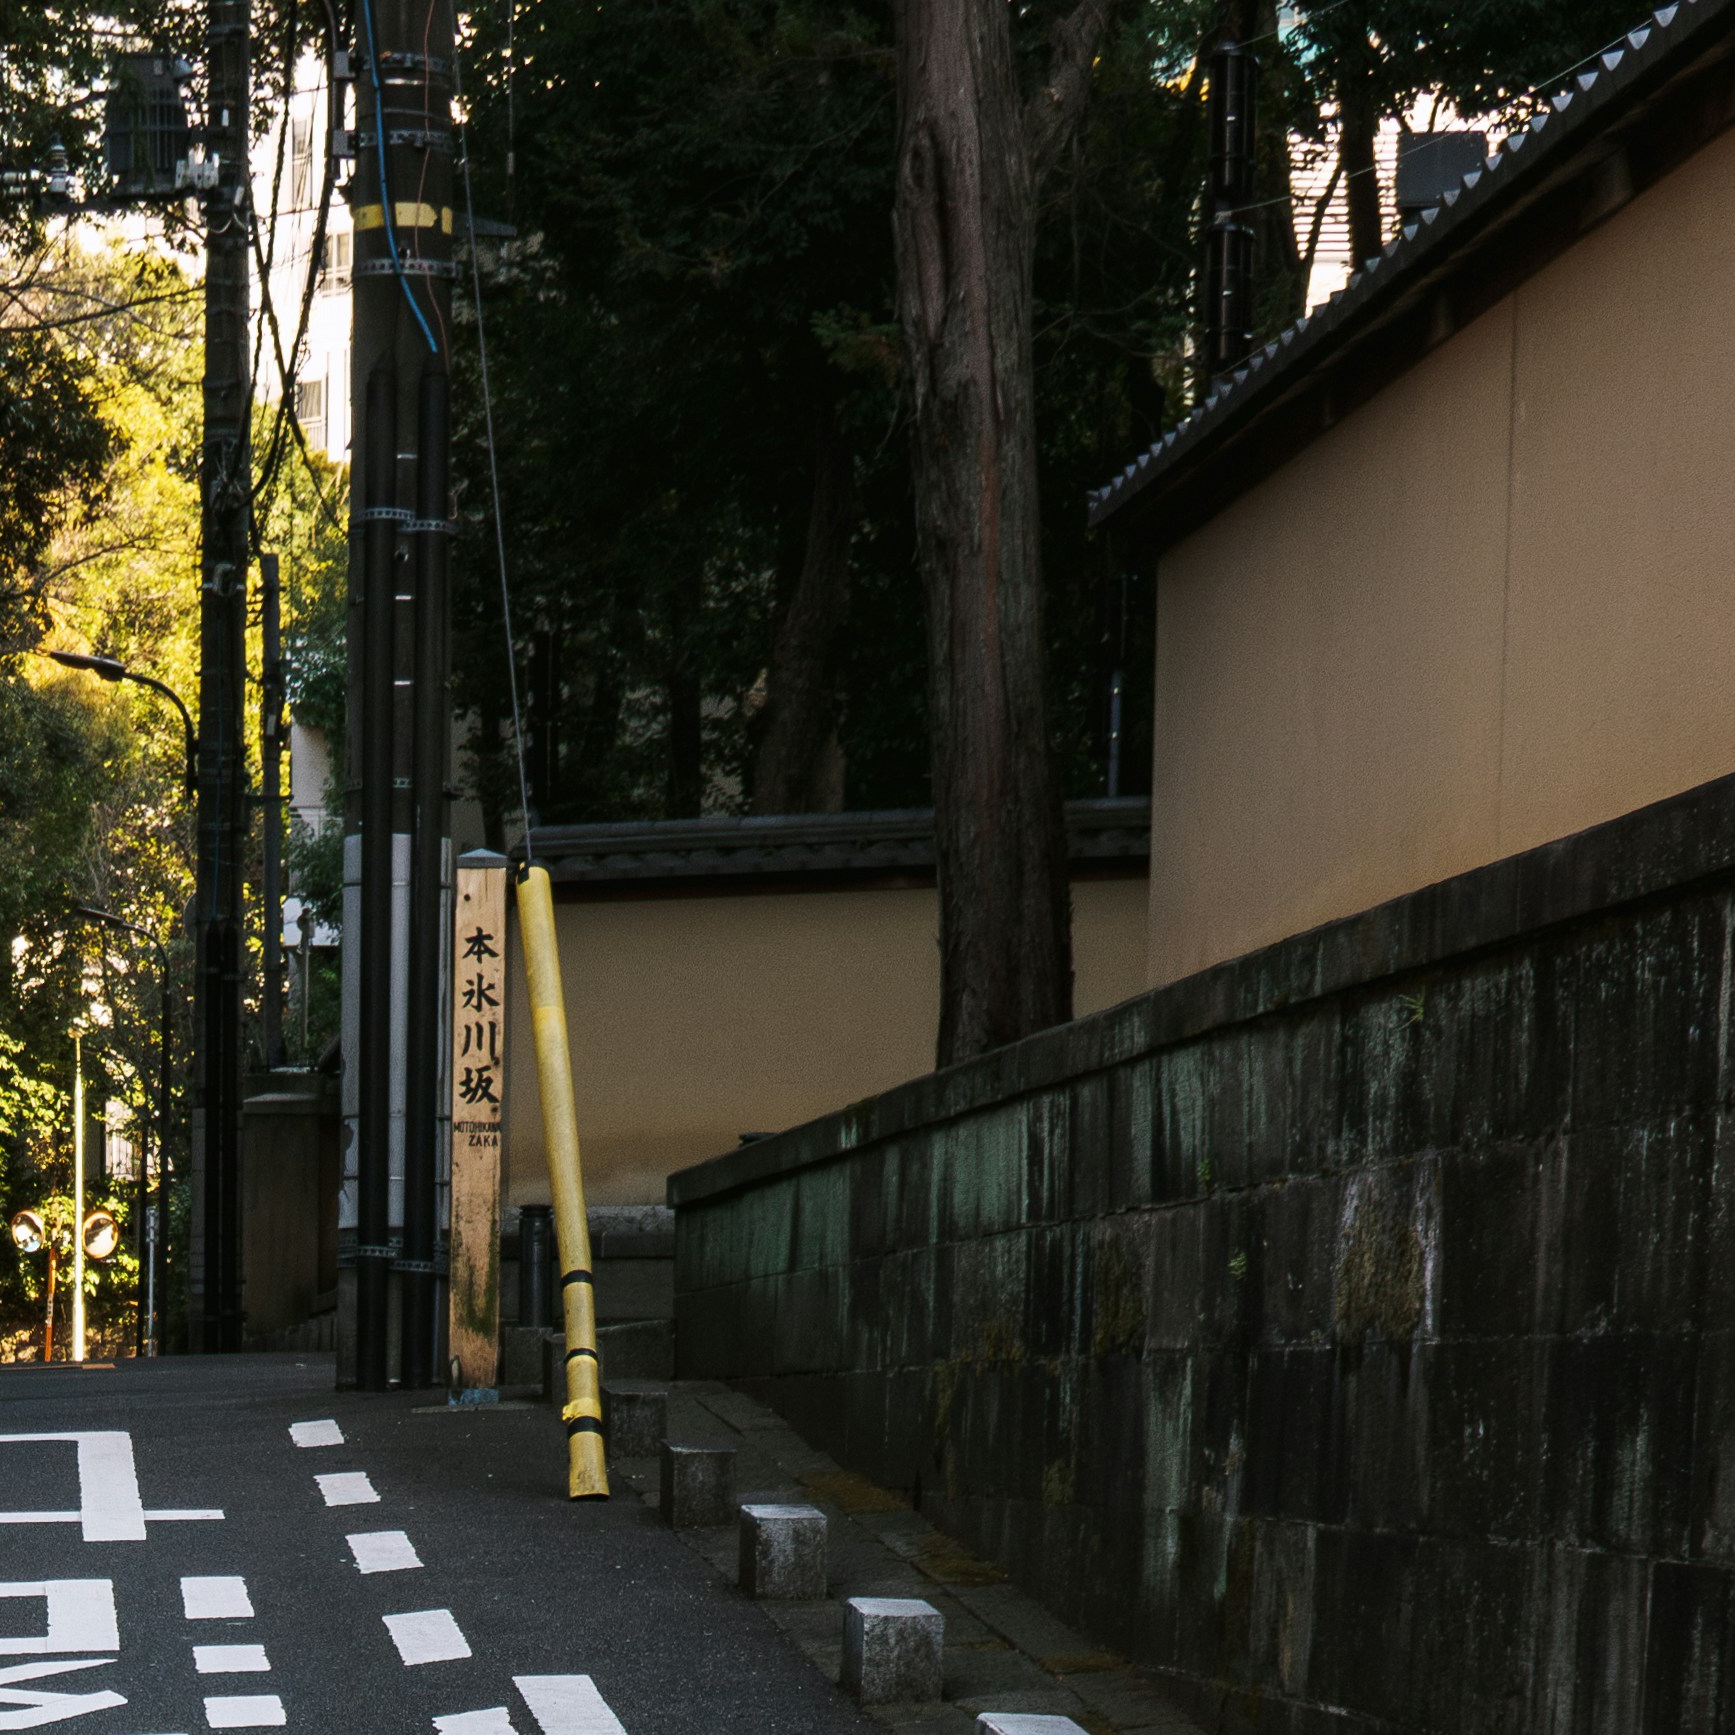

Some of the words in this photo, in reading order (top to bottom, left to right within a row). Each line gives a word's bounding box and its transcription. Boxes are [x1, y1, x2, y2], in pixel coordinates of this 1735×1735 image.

[459, 926, 501, 1105] 本氷川坂
[468, 1134, 498, 1148] ZAKA
